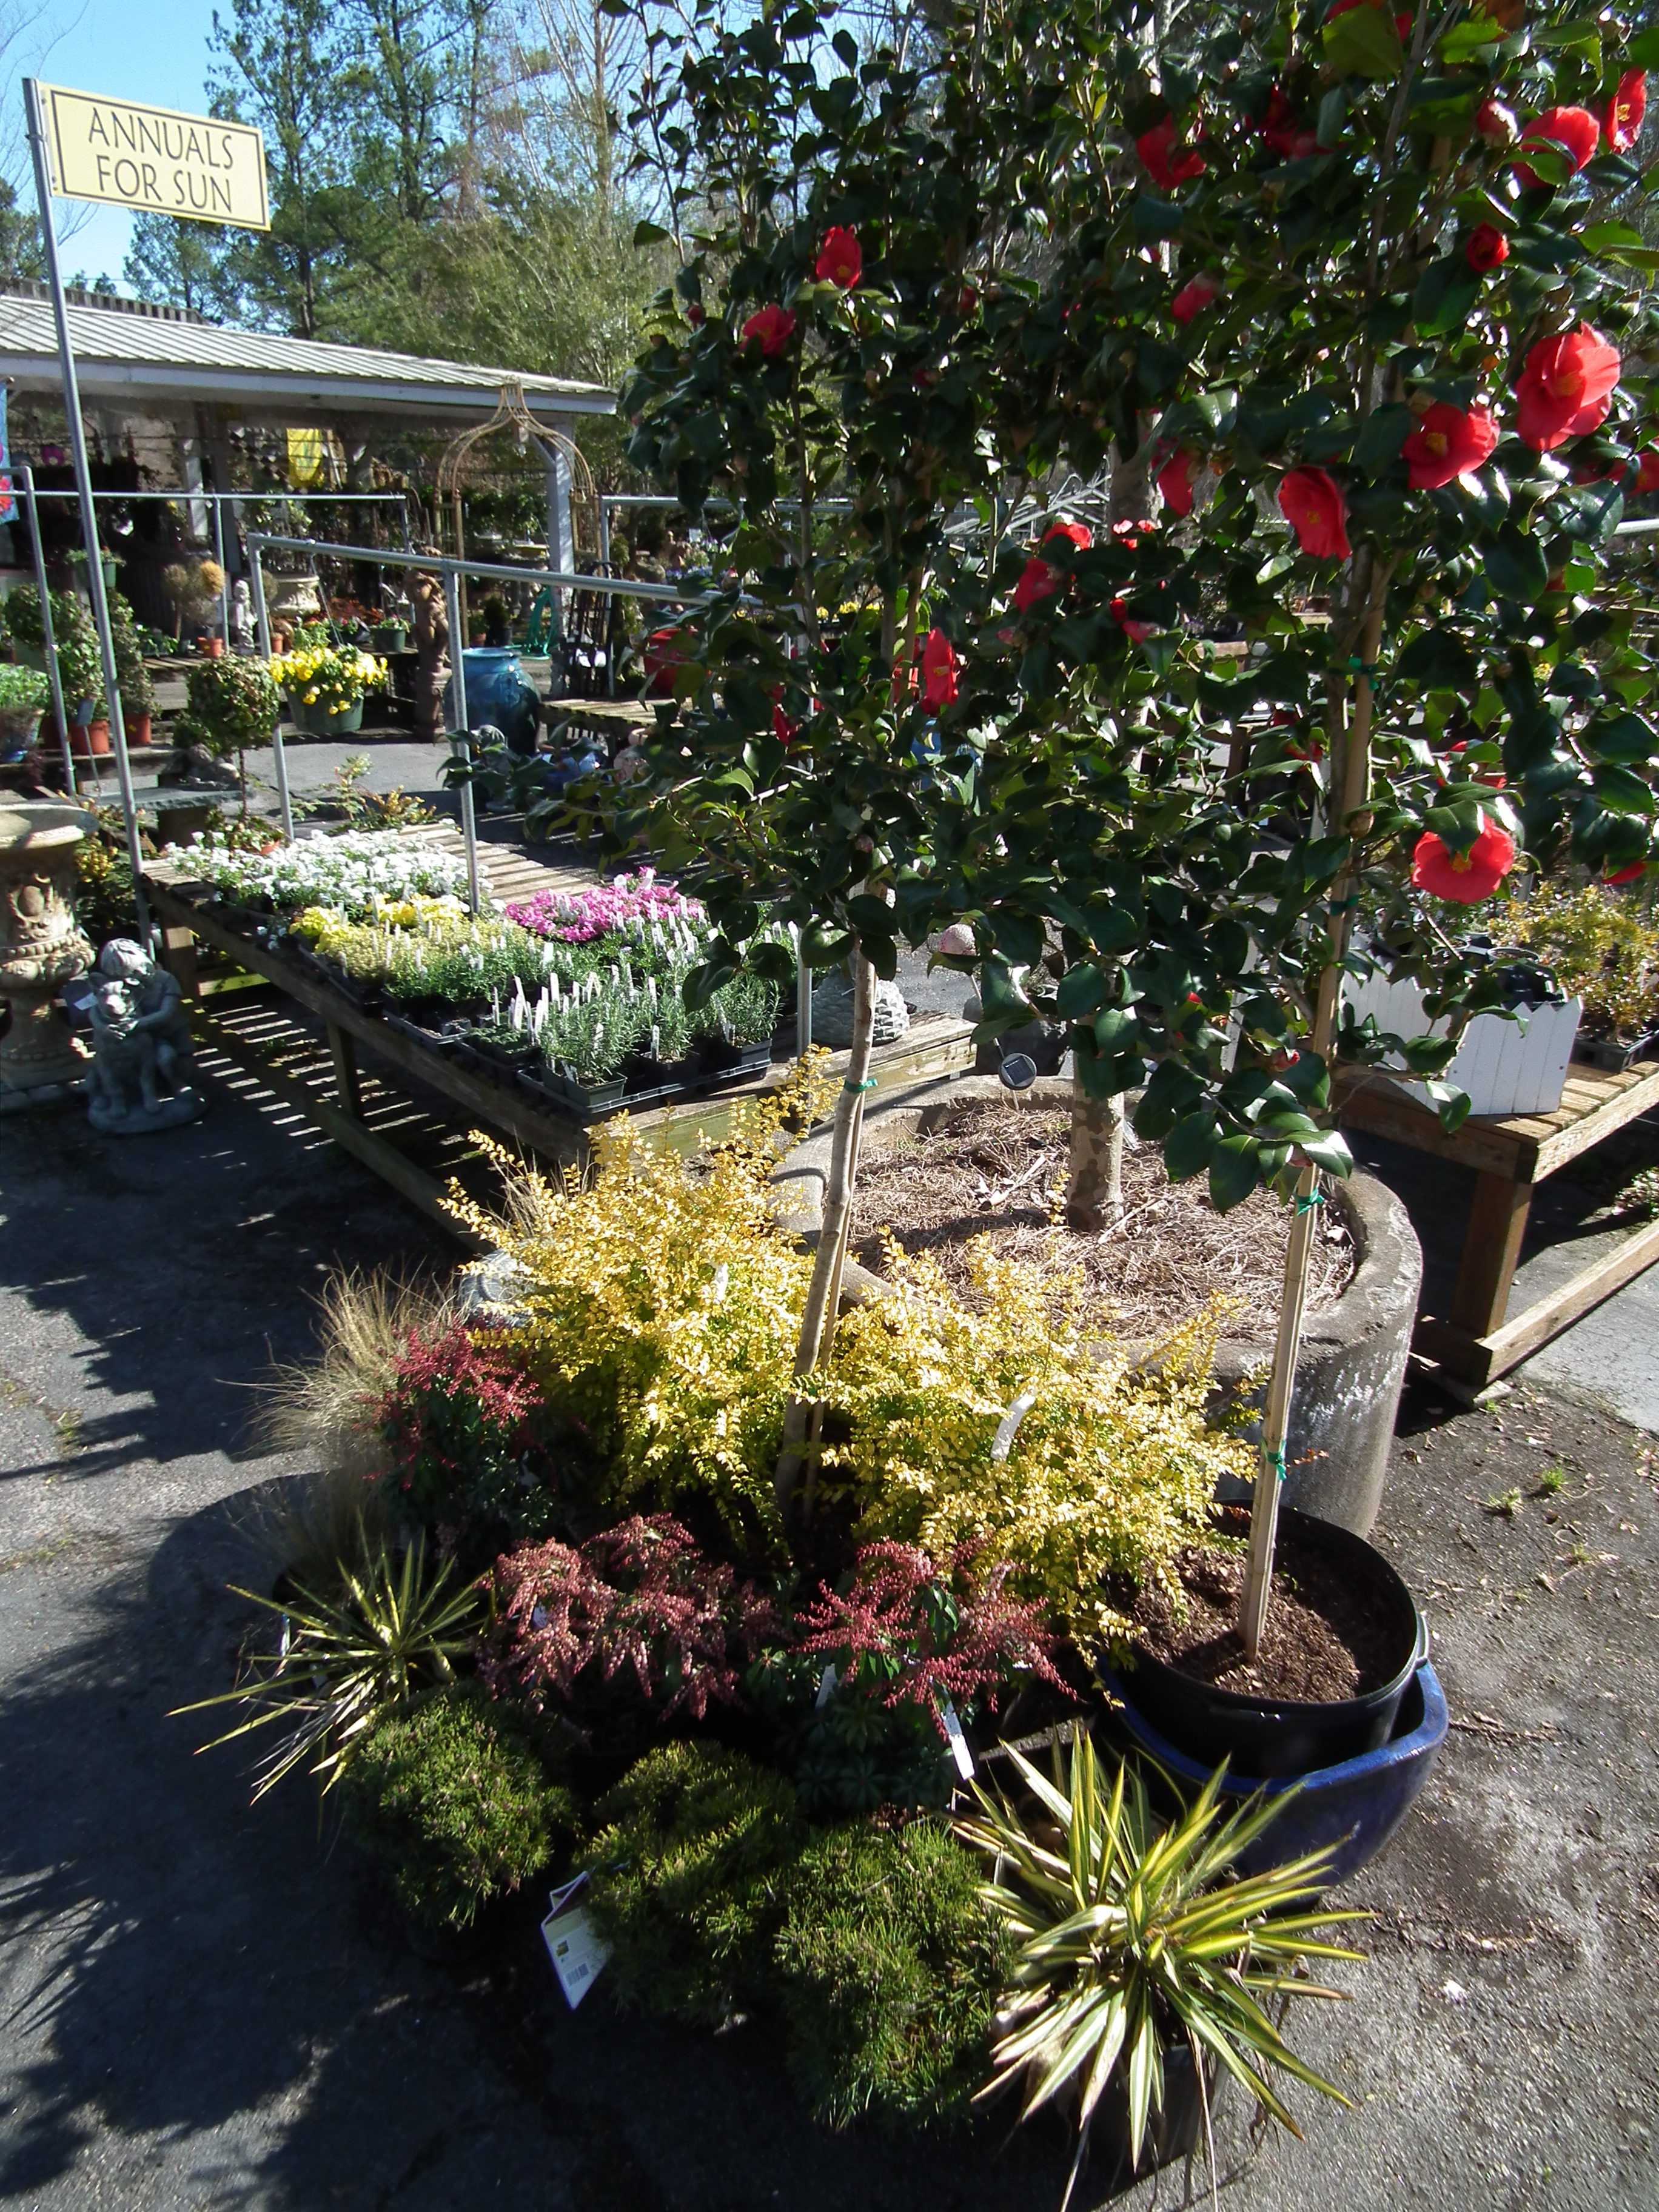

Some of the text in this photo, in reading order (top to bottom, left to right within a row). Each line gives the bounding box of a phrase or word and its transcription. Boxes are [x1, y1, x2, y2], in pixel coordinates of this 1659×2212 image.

[89, 107, 233, 170] ANNUALS
[96, 155, 232, 213] FOR SUN
